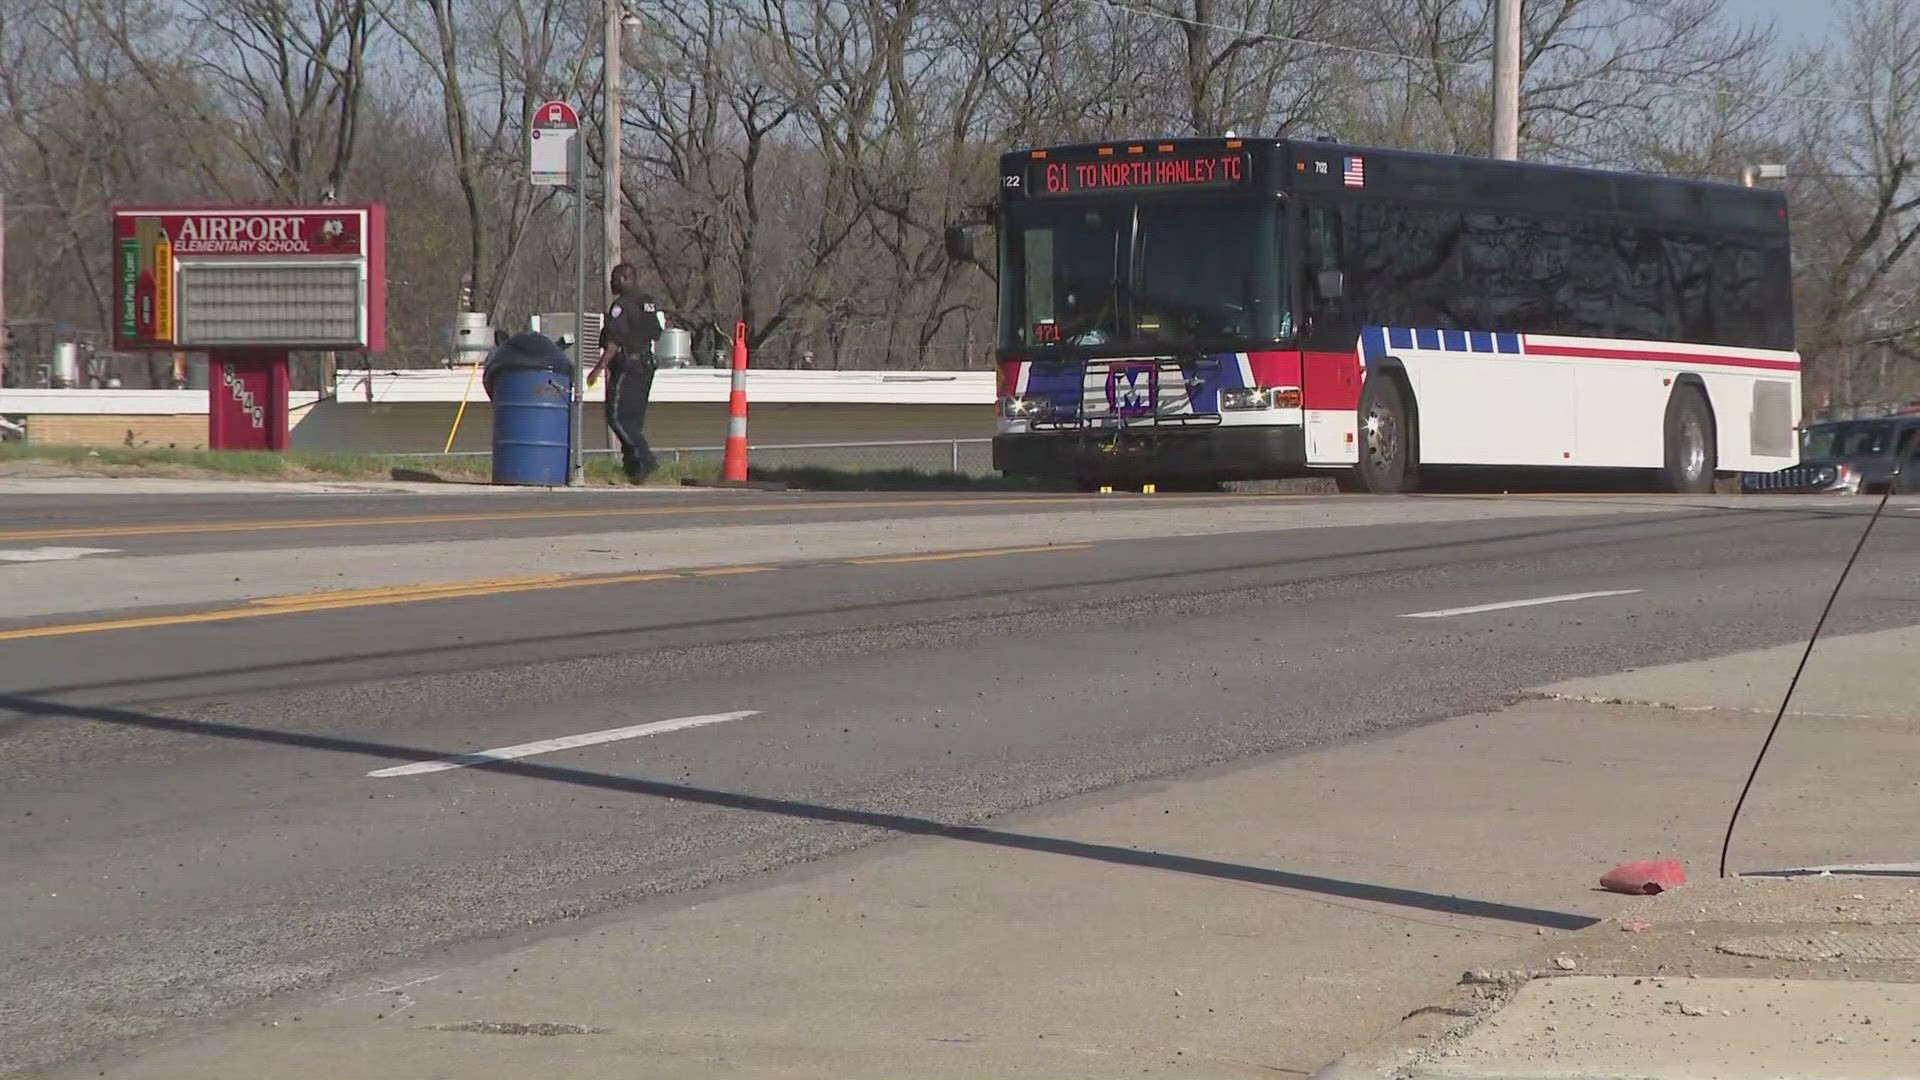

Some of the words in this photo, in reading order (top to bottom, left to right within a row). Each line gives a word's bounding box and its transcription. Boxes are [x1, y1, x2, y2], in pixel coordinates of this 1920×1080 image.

[1046, 163, 1070, 192] 61
[1076, 165, 1097, 188] TO
[1101, 162, 1151, 187] NORTH
[1155, 159, 1217, 183] HANLEY
[1221, 157, 1241, 180] TC
[178, 217, 305, 241] AIRPORT
[174, 239, 255, 252] ELEMENTARY
[257, 239, 311, 252] SCHOOL
[225, 366, 264, 427] 8249
